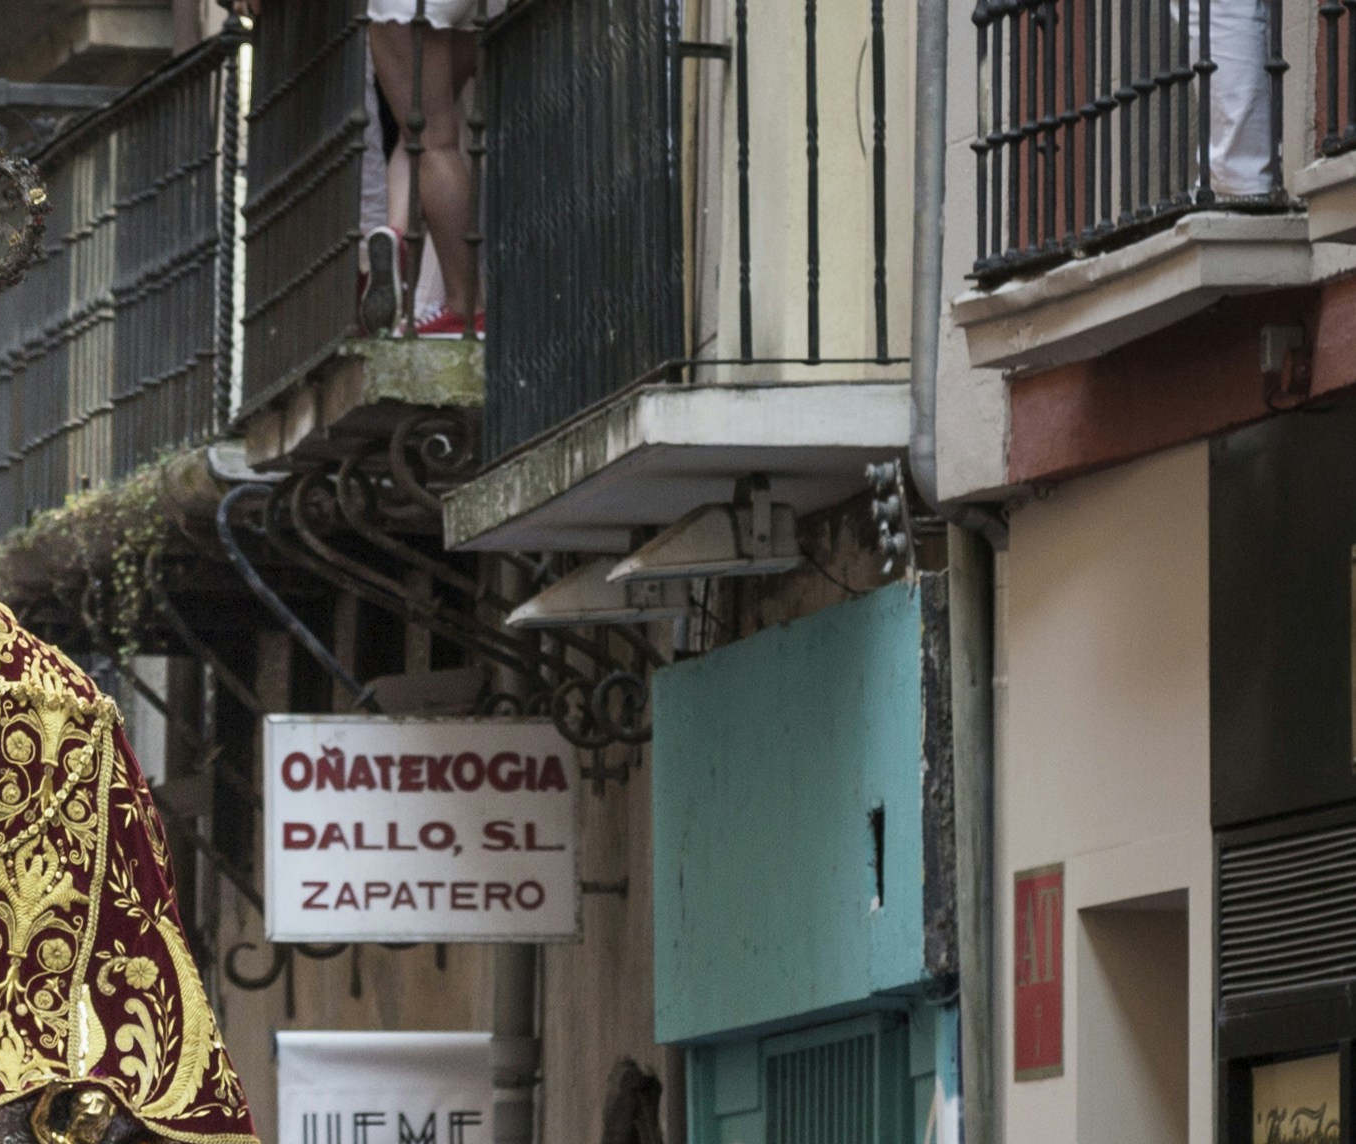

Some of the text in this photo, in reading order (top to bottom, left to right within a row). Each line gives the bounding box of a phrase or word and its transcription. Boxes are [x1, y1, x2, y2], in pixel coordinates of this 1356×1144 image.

[281, 745, 568, 793] OÑATEKOGIA
[283, 822, 462, 856] DALLO,
[302, 881, 546, 911] ZAPATERO
[1018, 886, 1060, 988] AT
